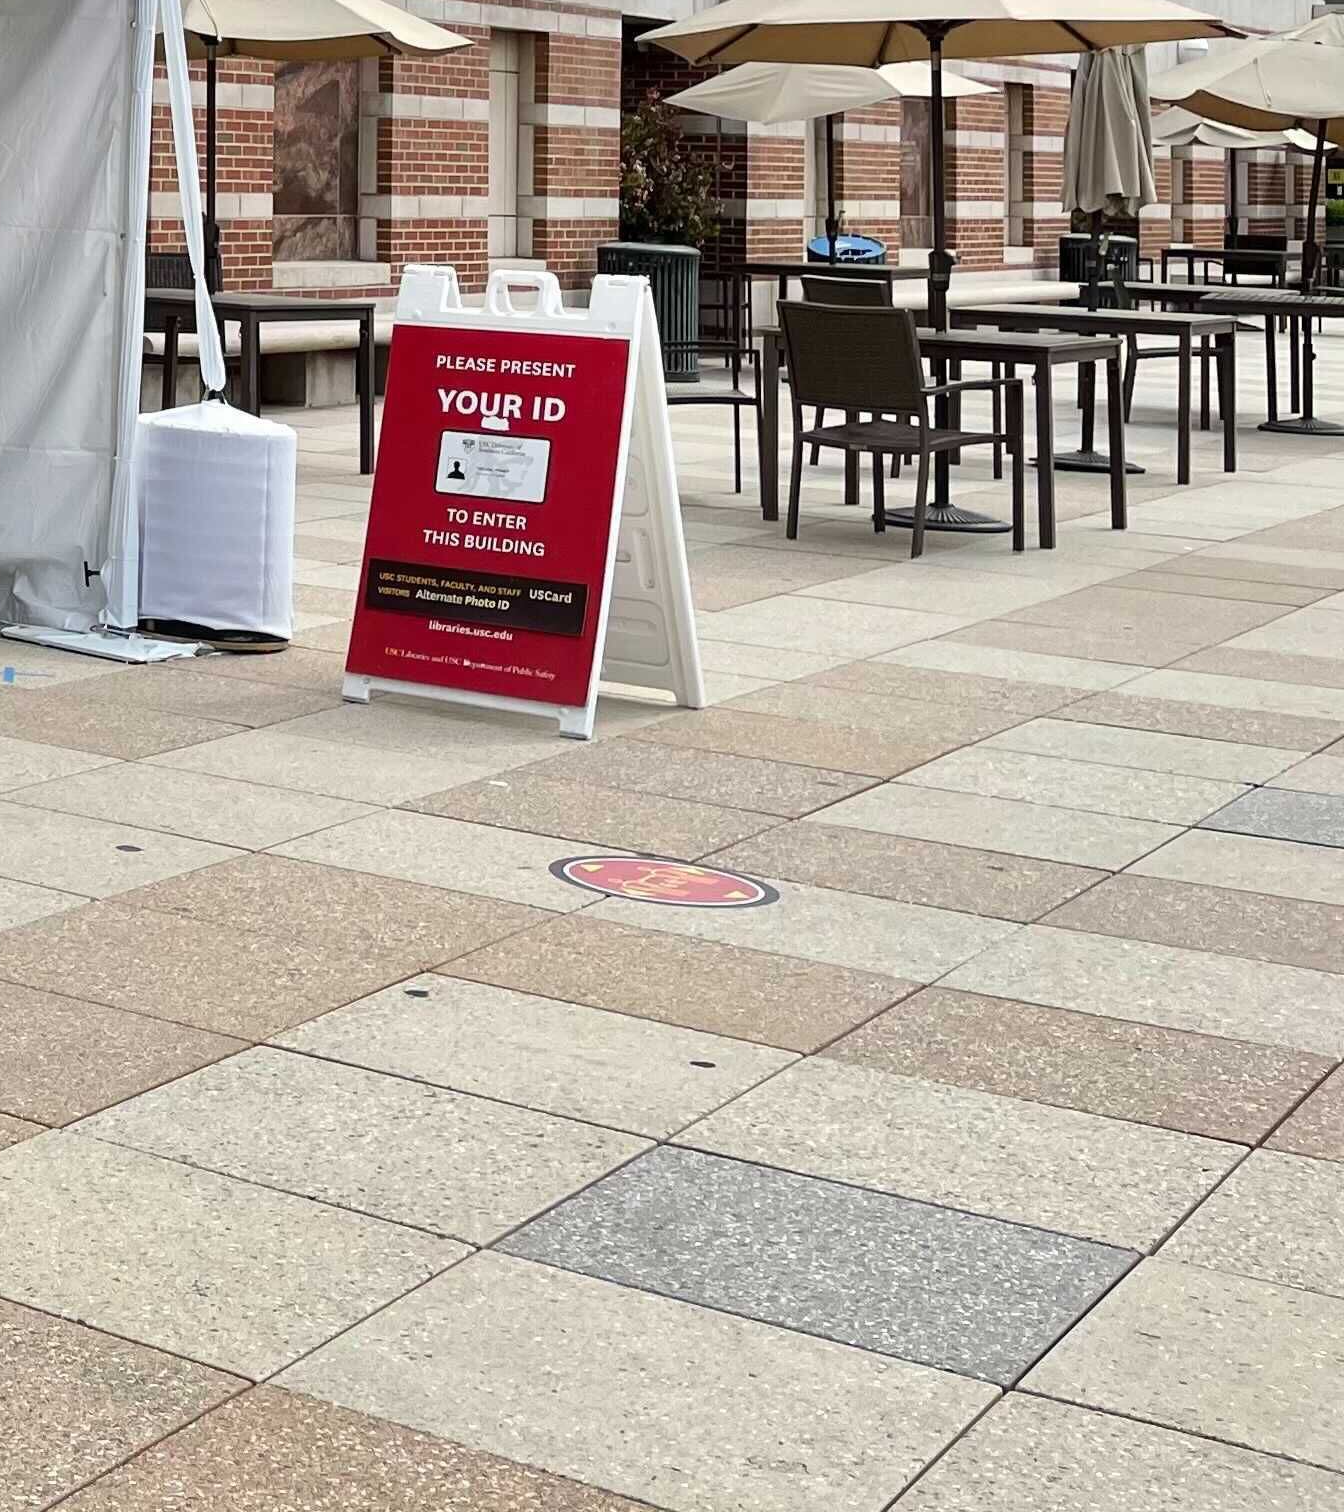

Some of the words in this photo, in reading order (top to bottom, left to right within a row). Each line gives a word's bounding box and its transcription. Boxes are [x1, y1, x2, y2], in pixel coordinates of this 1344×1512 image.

[436, 354, 497, 373] PLEASE
[500, 359, 576, 379] PRESENT
[437, 387, 523, 420] YOUR
[532, 396, 566, 422] ID
[447, 508, 469, 524] TO
[473, 511, 527, 531] ENTER
[423, 529, 460, 547] THIS
[464, 534, 545, 557] BUILDING
[416, 589, 463, 604] Alternate
[465, 595, 496, 609] Photo
[497, 599, 510, 611] ID
[478, 584, 496, 594] AND
[529, 588, 572, 604] USCard
[428, 619, 513, 641] libraries.usc.edu
